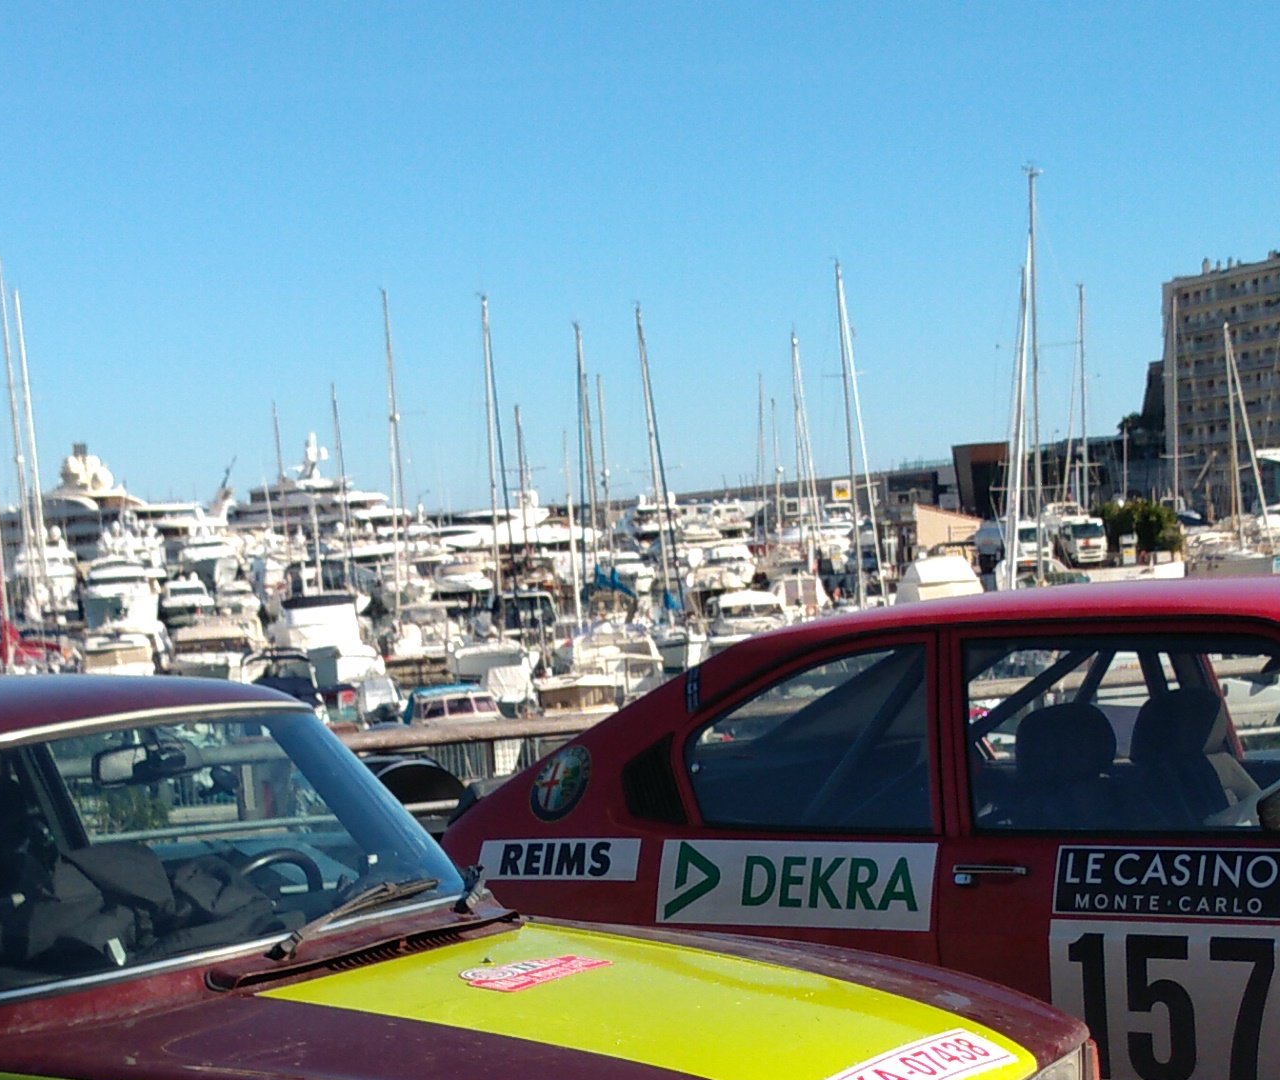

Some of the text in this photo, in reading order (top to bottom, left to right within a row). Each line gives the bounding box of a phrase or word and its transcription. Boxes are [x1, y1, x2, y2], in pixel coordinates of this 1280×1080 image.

[499, 842, 612, 876] REIMS
[1064, 853, 1279, 889] LE CASINO
[741, 855, 919, 912] DEKRA
